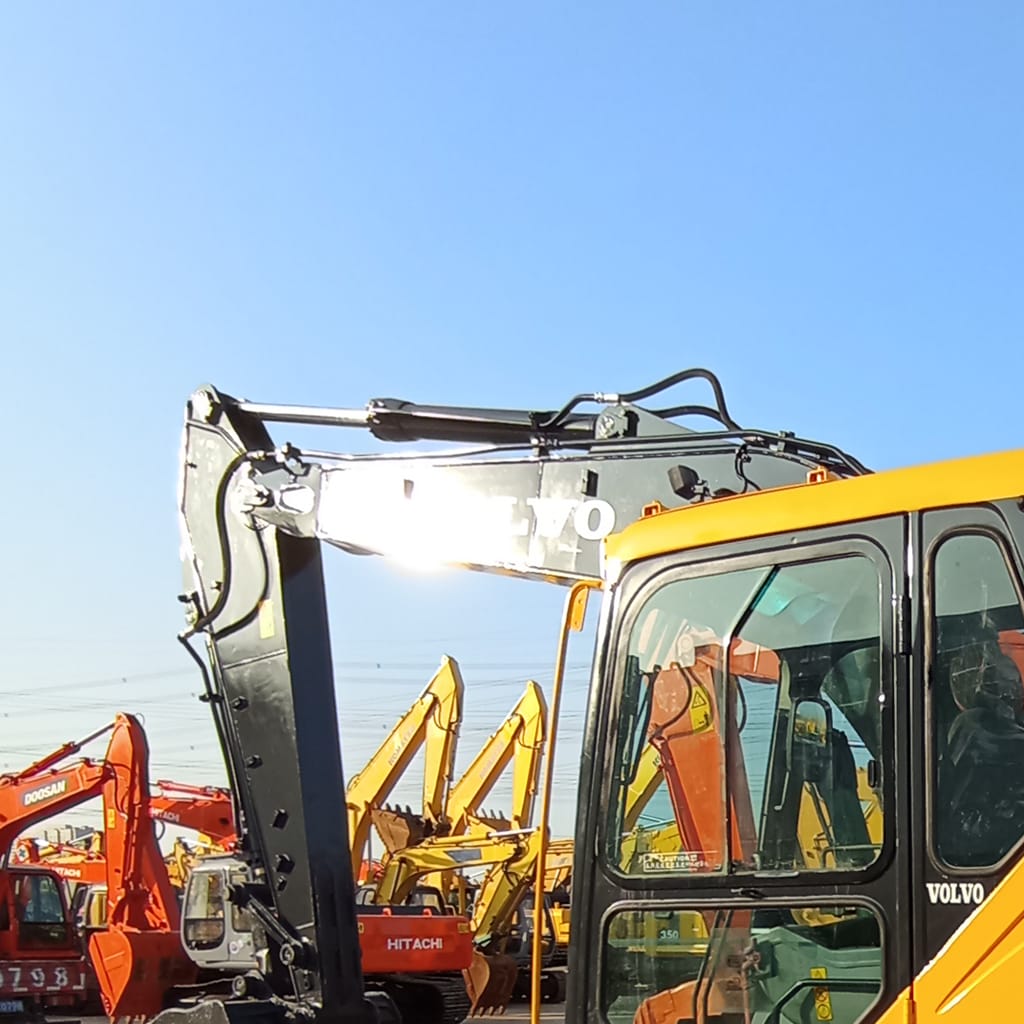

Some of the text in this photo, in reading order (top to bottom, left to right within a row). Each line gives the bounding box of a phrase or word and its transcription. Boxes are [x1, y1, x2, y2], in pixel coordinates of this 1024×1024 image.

[24, 780, 66, 805] DOOSAN
[926, 883, 984, 904] VOLVO
[387, 938, 443, 950] HITACHI
